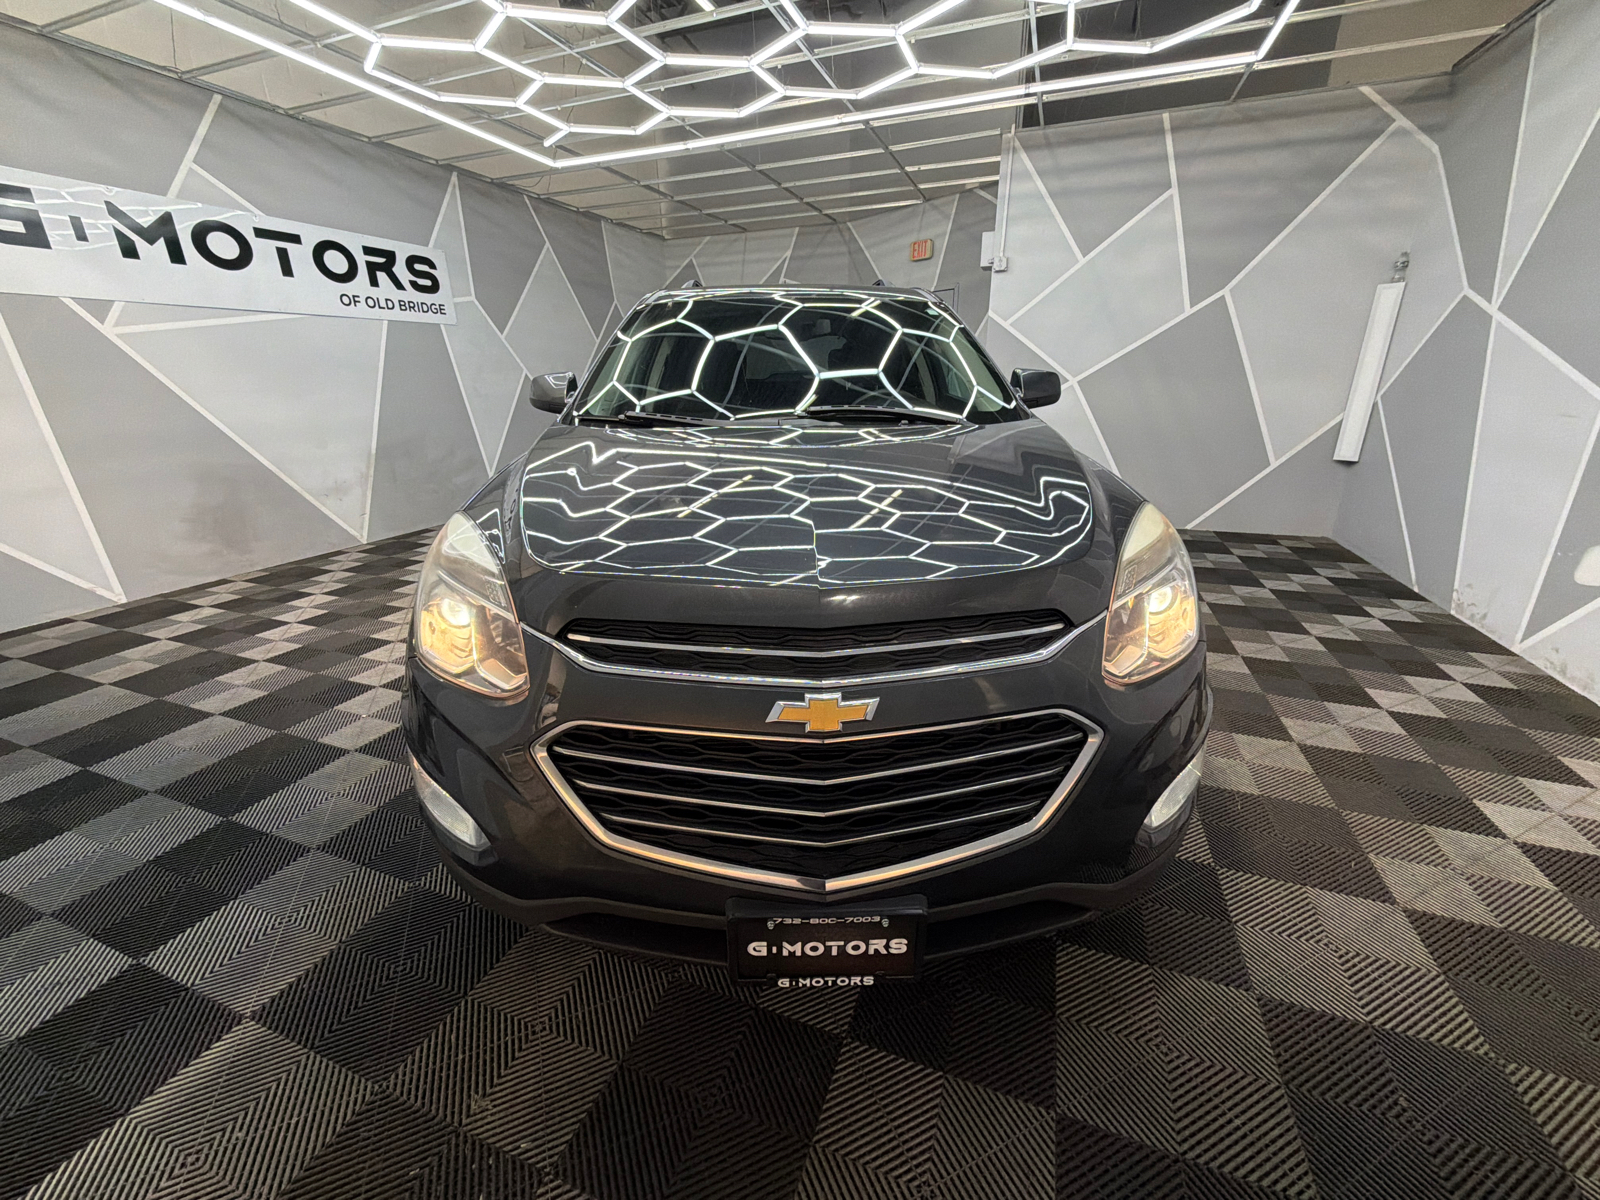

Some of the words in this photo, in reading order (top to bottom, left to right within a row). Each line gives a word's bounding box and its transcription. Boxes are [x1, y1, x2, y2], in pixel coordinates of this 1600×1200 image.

[912, 240, 928, 259] EXIT
[340, 293, 361, 307] OF
[364, 296, 395, 310] OLD
[398, 299, 446, 315] BRIDGE
